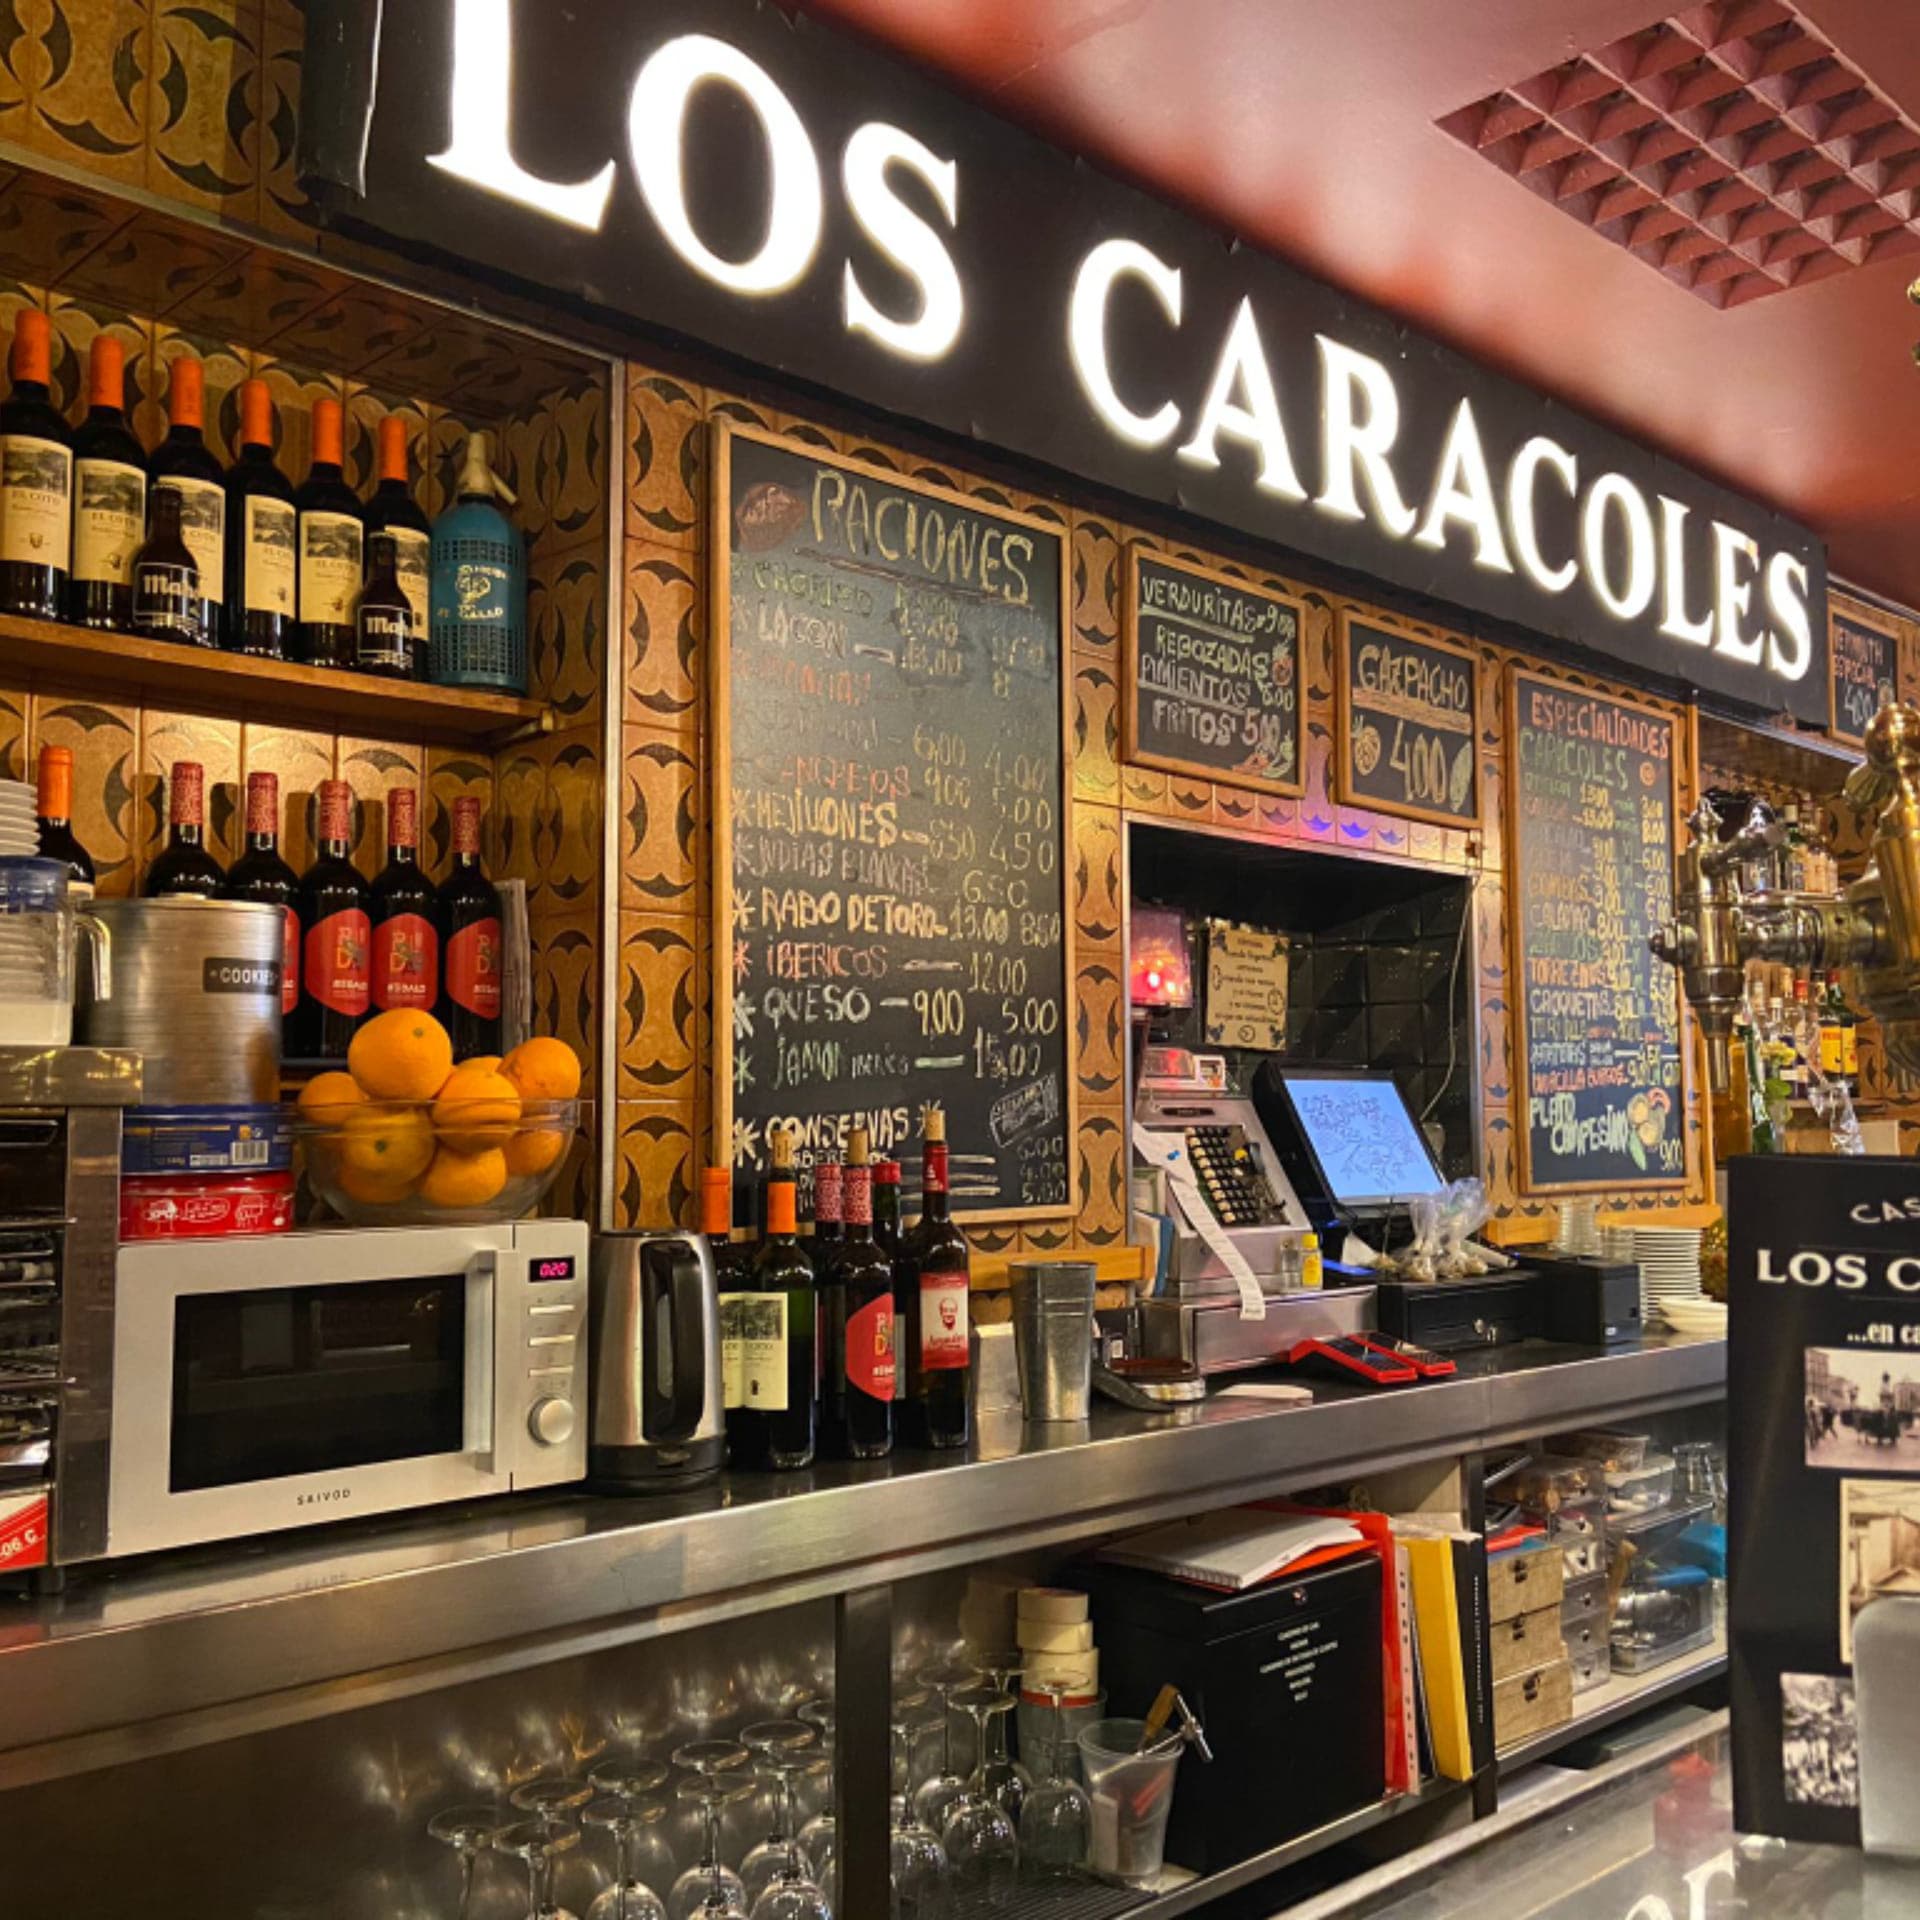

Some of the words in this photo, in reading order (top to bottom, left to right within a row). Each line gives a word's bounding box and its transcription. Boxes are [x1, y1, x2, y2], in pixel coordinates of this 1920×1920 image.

[426, 0, 963, 360] LOS
[1070, 238, 1811, 682] CARACOLES
[1142, 576, 1257, 633] VERDURITAS
[762, 886, 841, 932] RABO
[763, 984, 871, 1030] QUESO
[1757, 1249, 1868, 1289] LOS
[296, 1489, 351, 1506] SAIVOD
